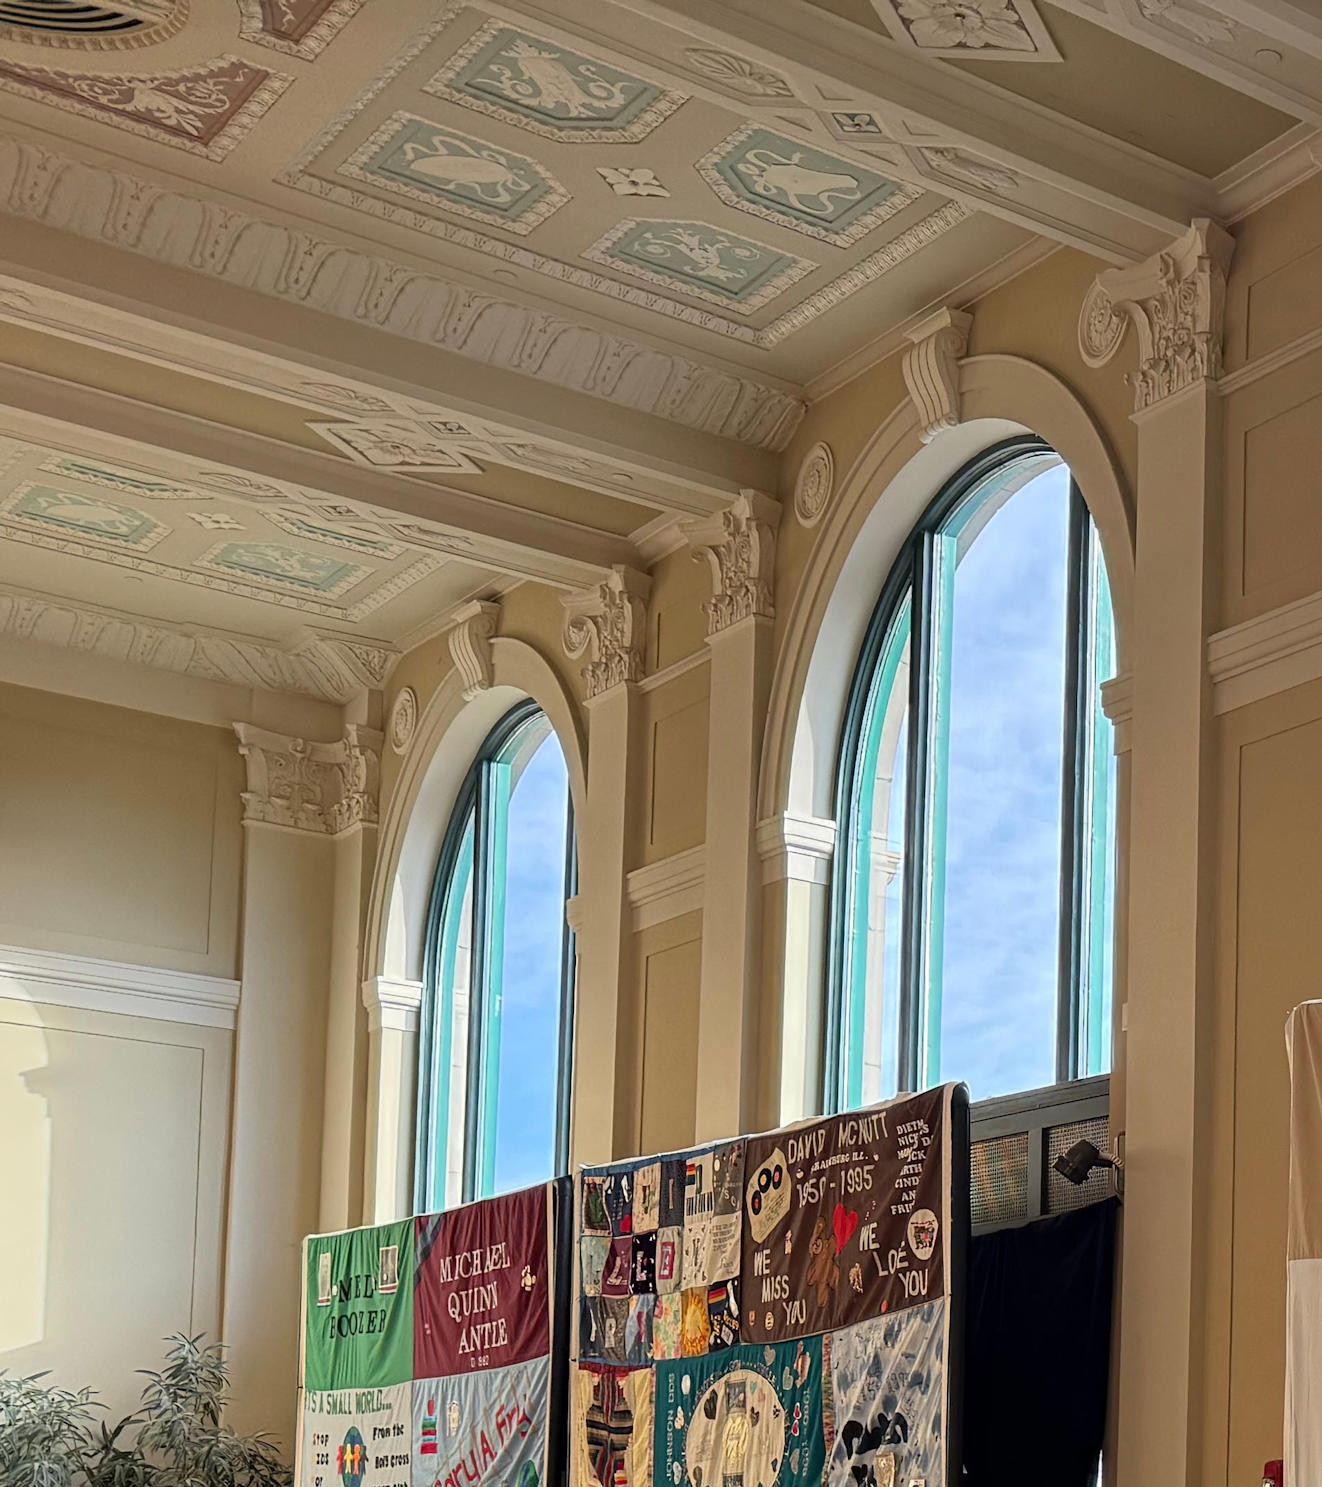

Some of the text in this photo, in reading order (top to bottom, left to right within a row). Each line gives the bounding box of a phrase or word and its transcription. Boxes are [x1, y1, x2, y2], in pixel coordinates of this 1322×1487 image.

[788, 1130, 826, 1165] DAVID
[840, 1164, 875, 1195] 1995
[859, 1222, 880, 1251] WE
[440, 1242, 511, 1283] MICHAEL
[754, 1249, 771, 1276] WE
[762, 1276, 790, 1303] MISS
[898, 1269, 929, 1299] YOU
[448, 1281, 498, 1321] QUINN
[783, 1299, 807, 1325] YOU
[458, 1318, 508, 1354] ANTLE
[326, 1393, 352, 1415] SMALL
